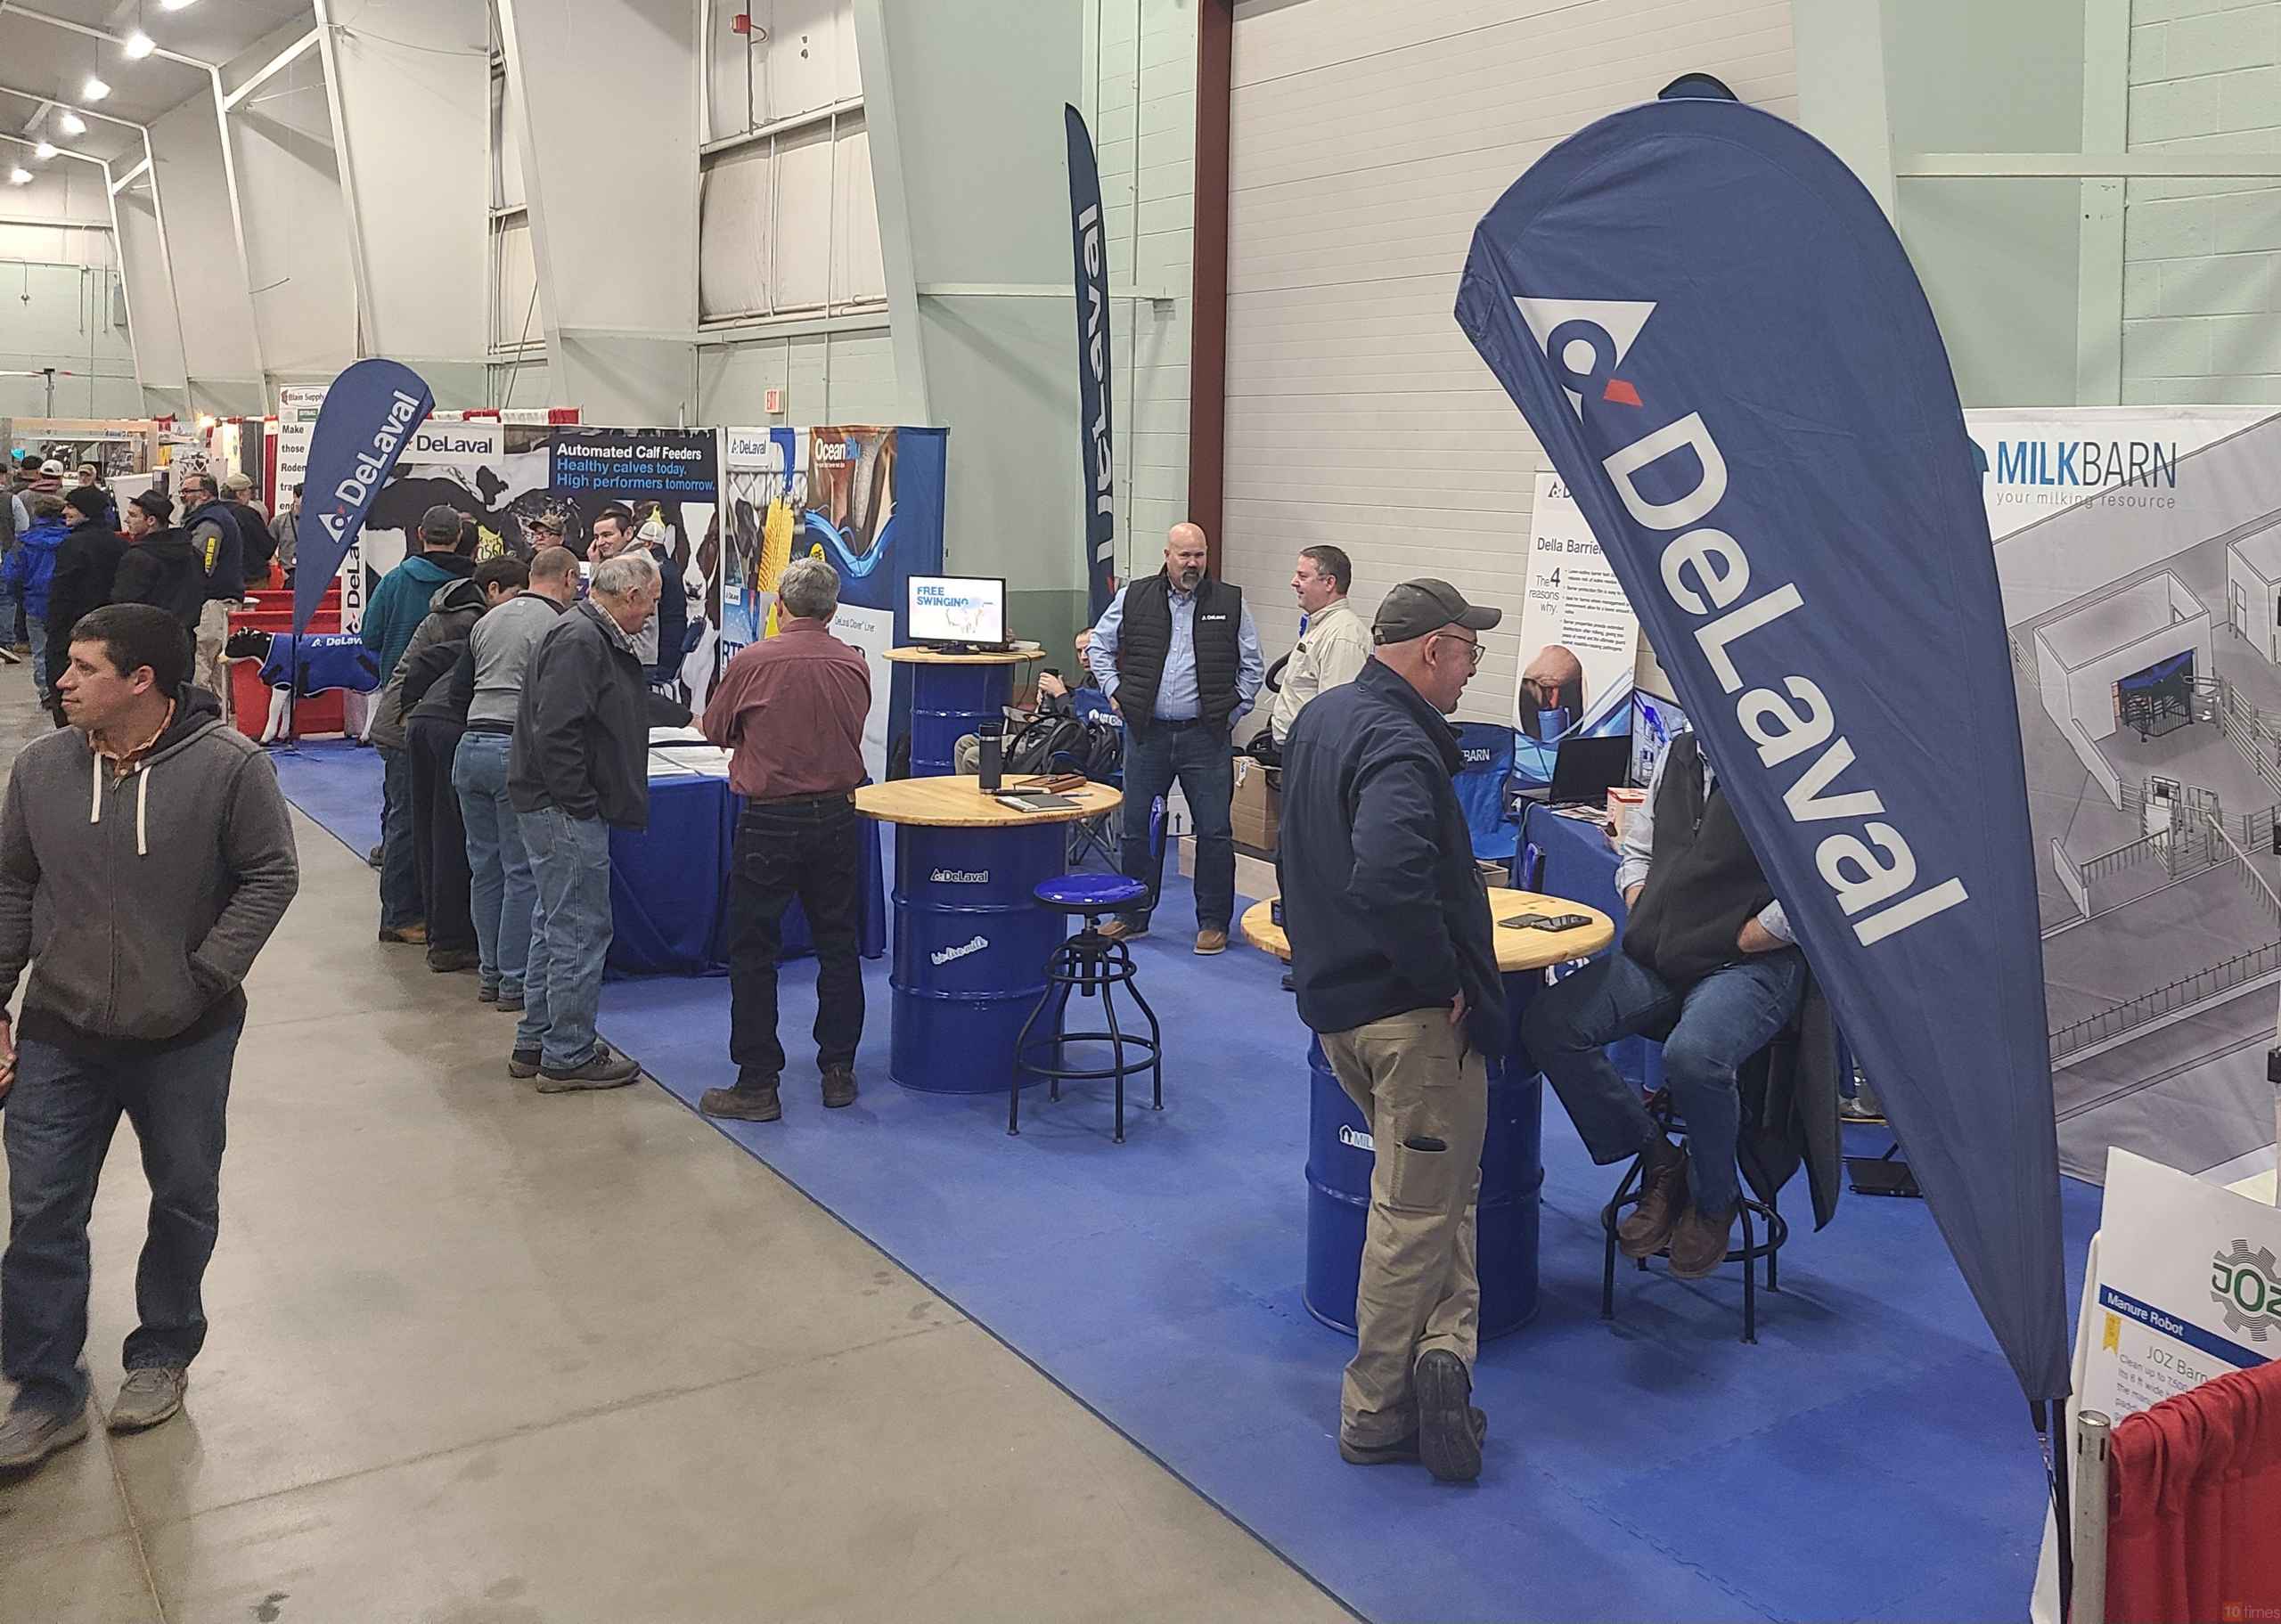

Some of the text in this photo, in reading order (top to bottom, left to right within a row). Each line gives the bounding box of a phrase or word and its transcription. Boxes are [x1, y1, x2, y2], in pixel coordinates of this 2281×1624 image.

[282, 425, 304, 435] Make
[282, 444, 305, 453] those
[335, 389, 421, 507] DeLaval
[416, 435, 493, 453] DeLaval
[557, 443, 702, 461] Automated Calf Feeders
[740, 439, 766, 455] DeLaval
[557, 458, 687, 477] Healthy calves today.
[1996, 441, 2178, 488] MILKBARN
[557, 474, 715, 491] High performers tomorrow.
[1996, 491, 2176, 510] your milking resource
[1537, 537, 1563, 552] Della
[1536, 575, 1550, 587] The
[1550, 567, 1561, 588] 4
[917, 586, 945, 596] FREE
[1528, 589, 1560, 600] reasons
[1602, 410, 1970, 948] DeLaval
[1461, 748, 1491, 763] BARN
[944, 870, 989, 883] DeLaval
[2107, 1293, 2184, 1336] Manure Robot
[2119, 1353, 2143, 1374] Clean
[2146, 1345, 2174, 1369] JOZ
